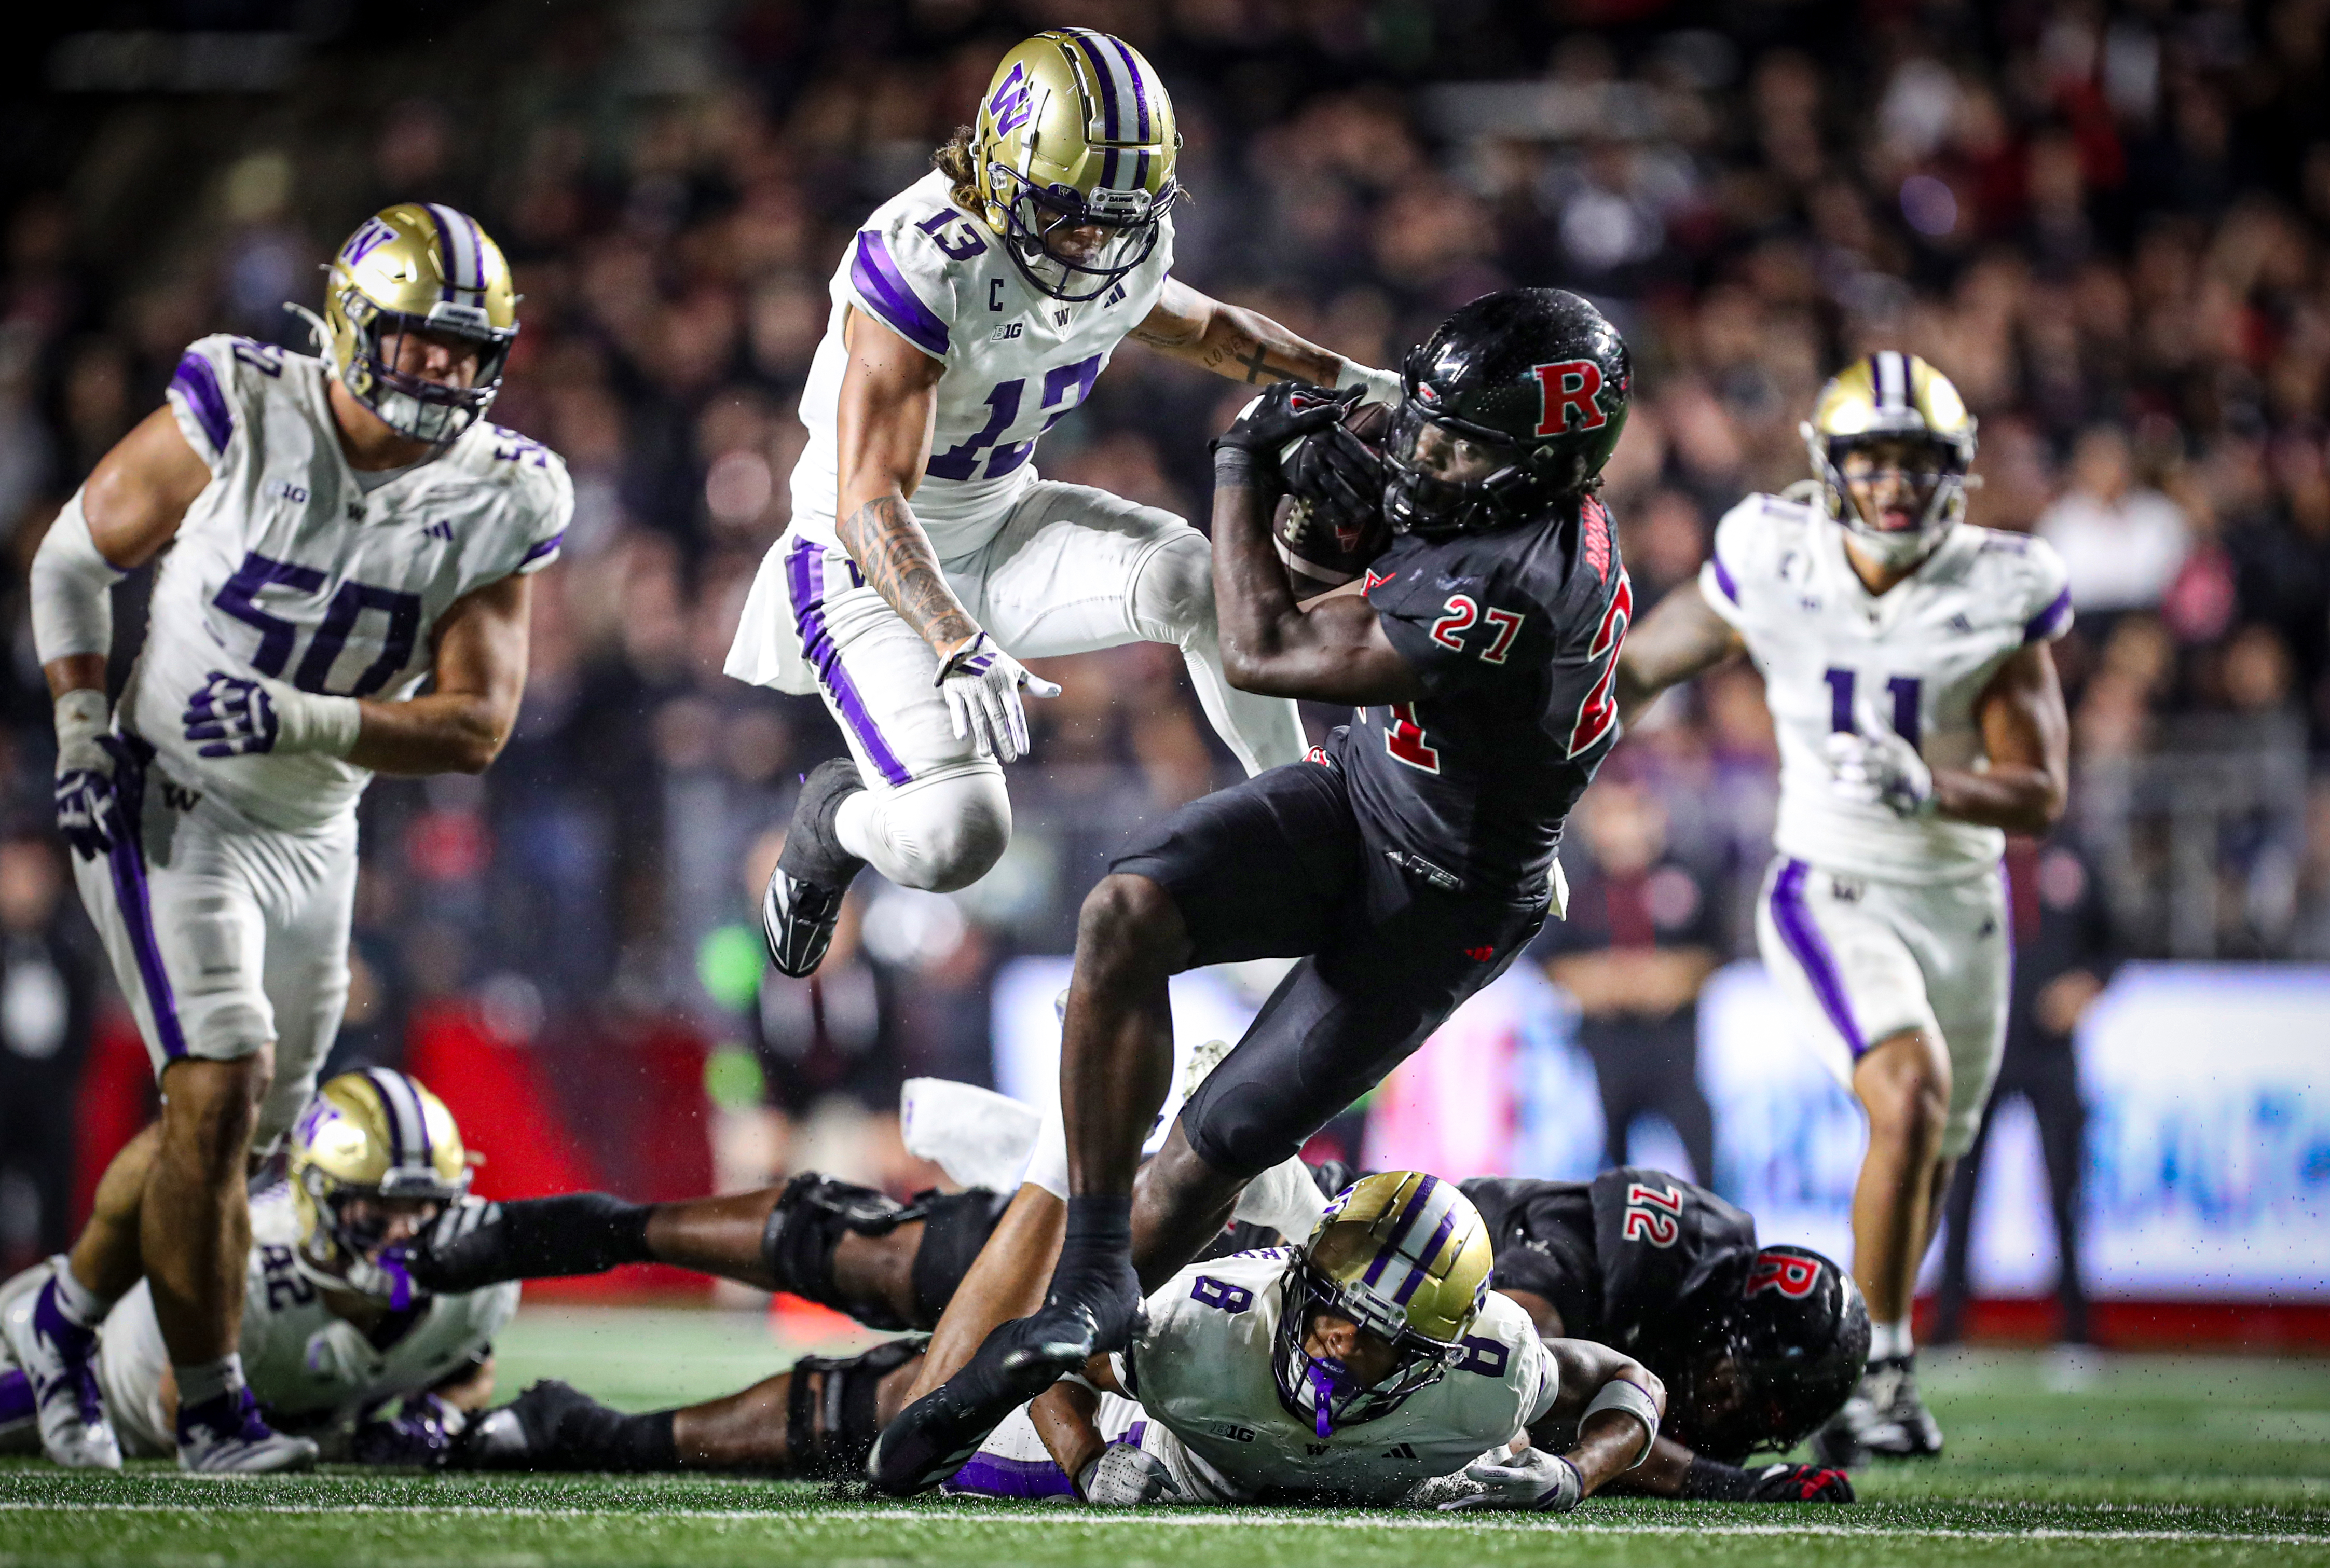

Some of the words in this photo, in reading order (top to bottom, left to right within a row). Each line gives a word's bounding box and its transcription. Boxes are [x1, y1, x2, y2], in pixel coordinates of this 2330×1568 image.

[989, 60, 1034, 141] W
[340, 216, 401, 267] W
[914, 208, 988, 260] 13
[989, 279, 1004, 311] C
[1054, 307, 1070, 327] W
[925, 352, 1103, 480] 13
[1533, 359, 1607, 437] R
[213, 551, 421, 696] 50
[1429, 594, 1525, 665] 27
[1825, 668, 1921, 758] 11
[1623, 1183, 1683, 1248] 72
[1190, 1275, 1253, 1314] 8
[1747, 1251, 1824, 1299] R
[1453, 1333, 1509, 1378] 8
[1306, 1443, 1330, 1456] W
